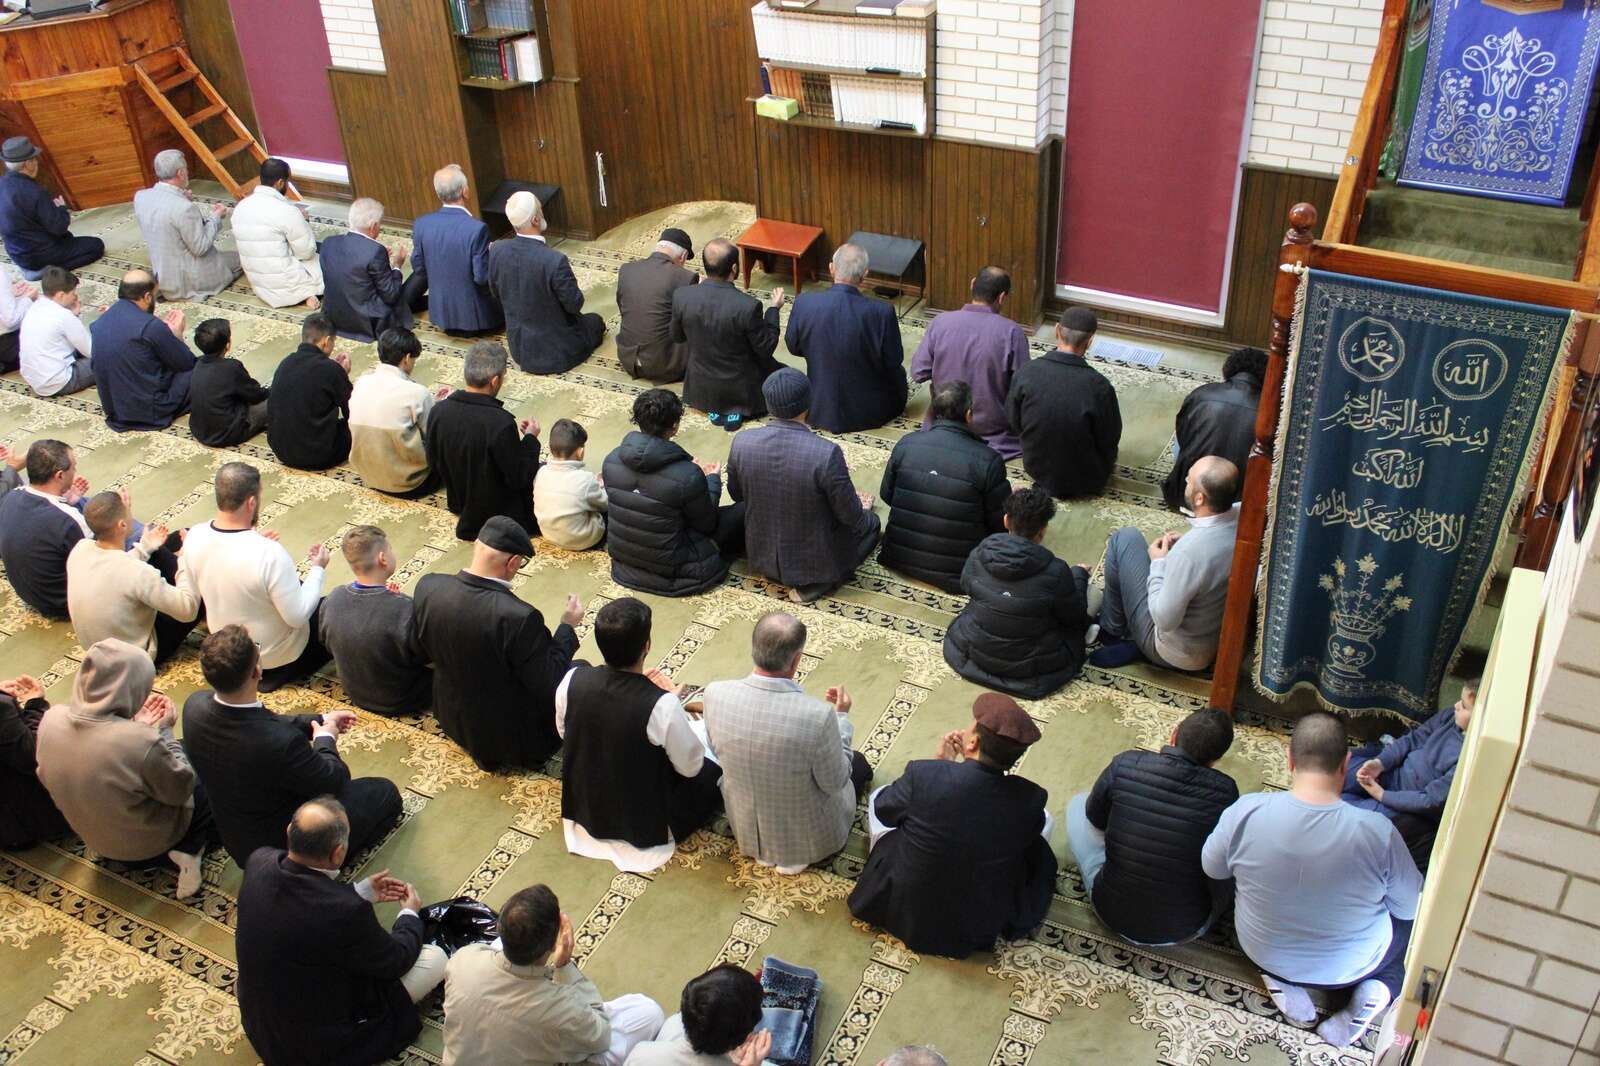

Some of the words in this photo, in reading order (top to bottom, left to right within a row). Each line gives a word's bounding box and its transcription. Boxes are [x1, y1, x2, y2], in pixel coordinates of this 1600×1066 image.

[1351, 331, 1395, 372] محمد
[1444, 353, 1490, 392] الله
[1415, 397, 1451, 436] الله
[1420, 416, 1490, 453] بسم
